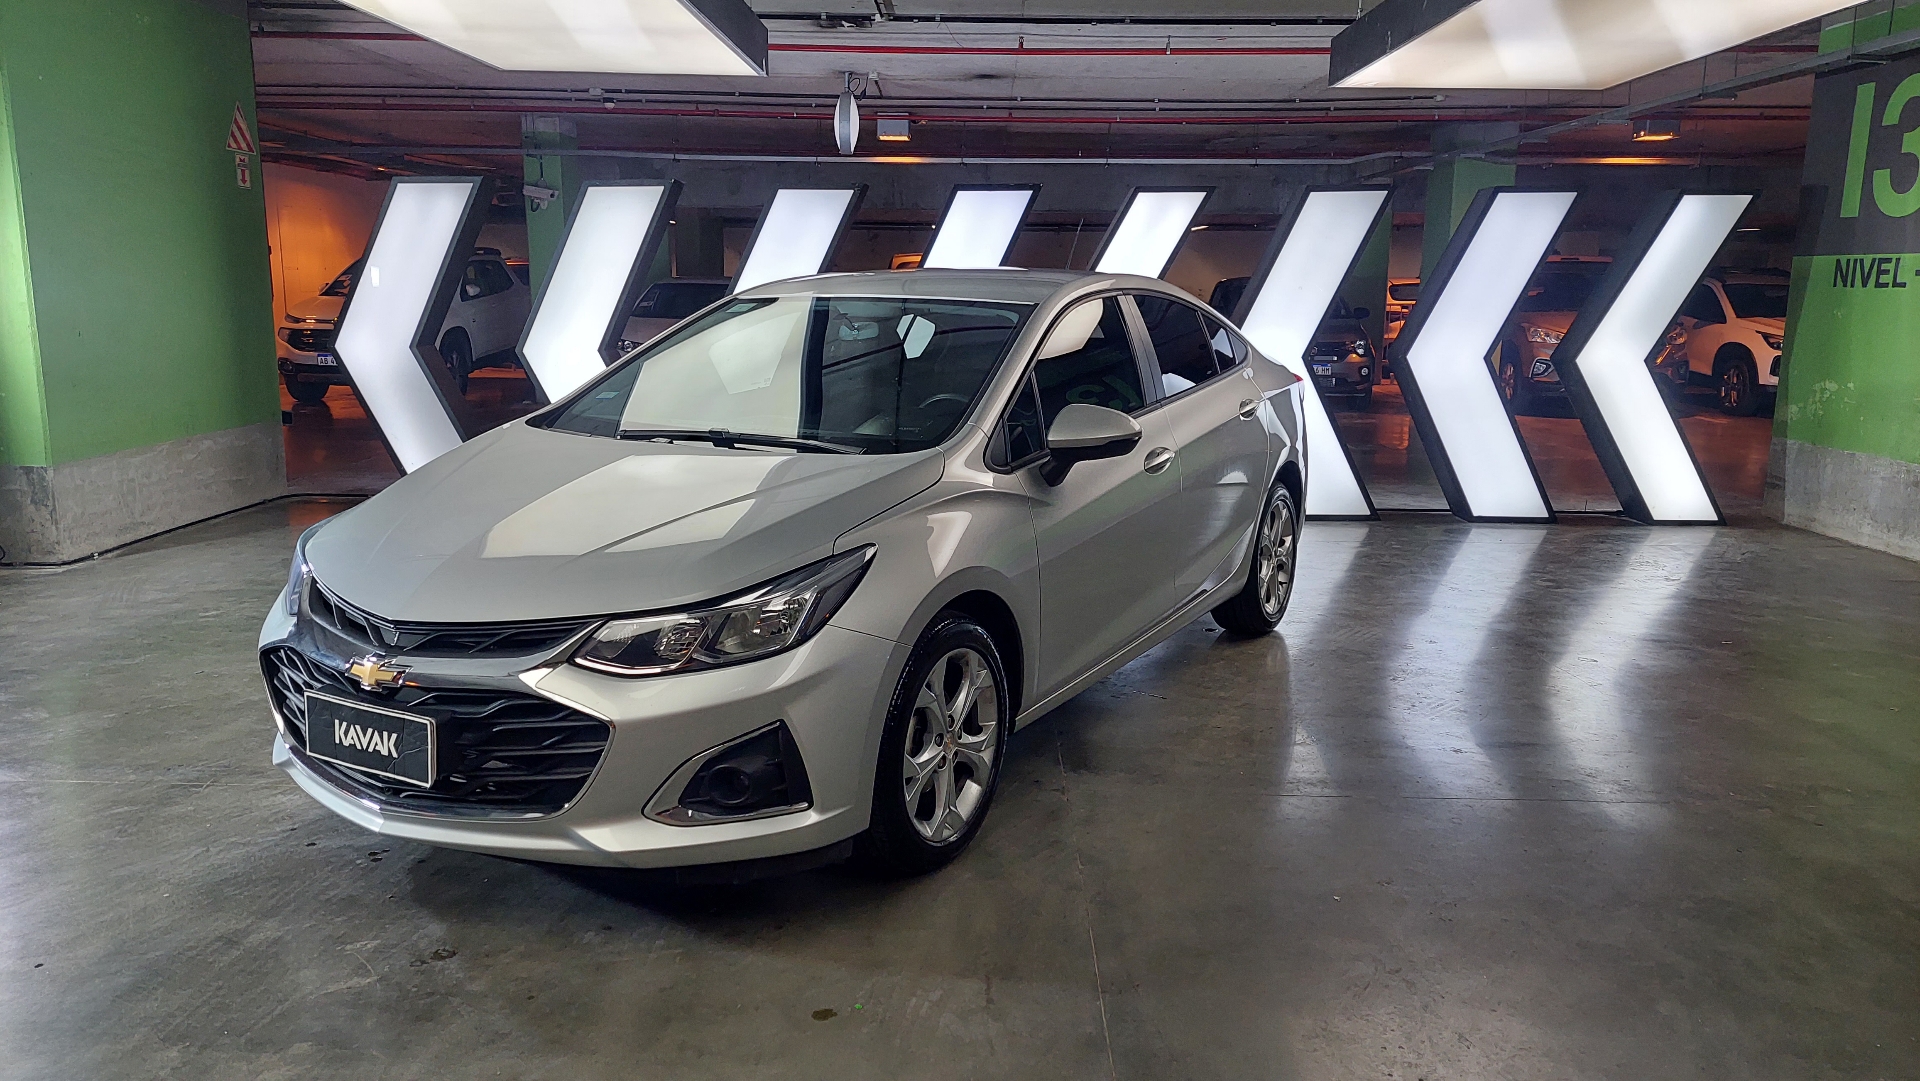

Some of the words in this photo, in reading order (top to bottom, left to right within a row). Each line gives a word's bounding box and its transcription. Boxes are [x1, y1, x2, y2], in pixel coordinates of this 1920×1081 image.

[1840, 72, 1920, 218] 13
[1833, 257, 1907, 288] NIVEL
[334, 719, 398, 758] KAVAK
